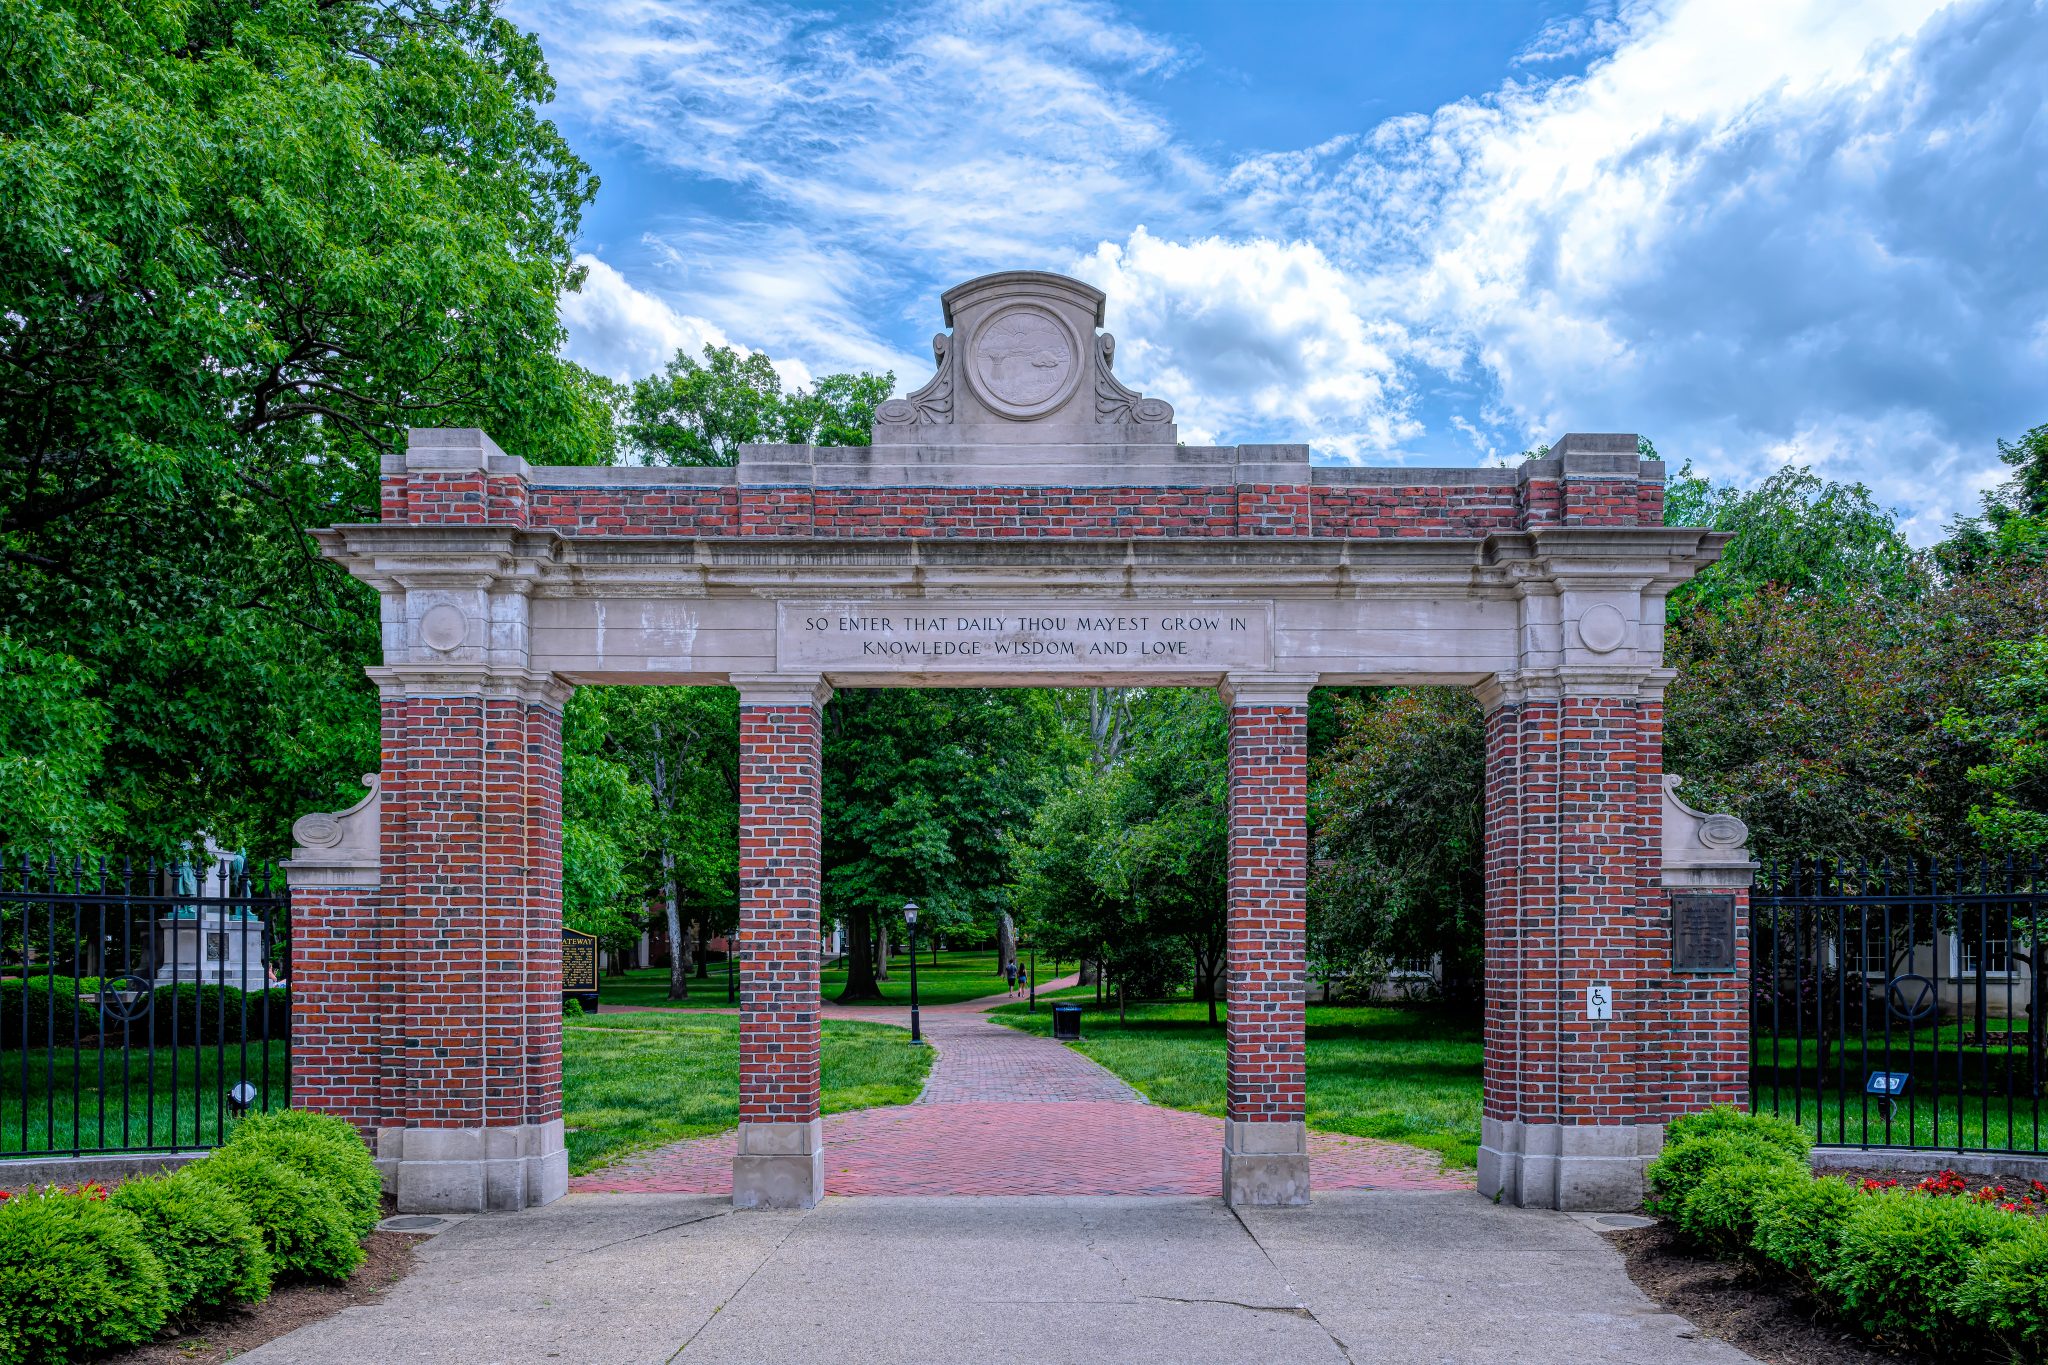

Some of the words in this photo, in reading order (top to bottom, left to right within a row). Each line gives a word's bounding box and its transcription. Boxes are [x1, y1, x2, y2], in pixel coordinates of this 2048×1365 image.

[805, 617, 829, 631] SO
[839, 617, 894, 631] ENTER
[904, 617, 948, 631] THAT
[957, 617, 1007, 631] DAILY
[1018, 617, 1066, 631] THOU
[1076, 617, 1149, 632] MAYEST
[1161, 617, 1220, 631] GROW
[1230, 617, 1246, 631] IN
[863, 641, 981, 655] KNOWLEDGE
[995, 641, 1075, 655] WISDOM
[1089, 641, 1128, 655] AND
[1141, 641, 1188, 655] LOVE
